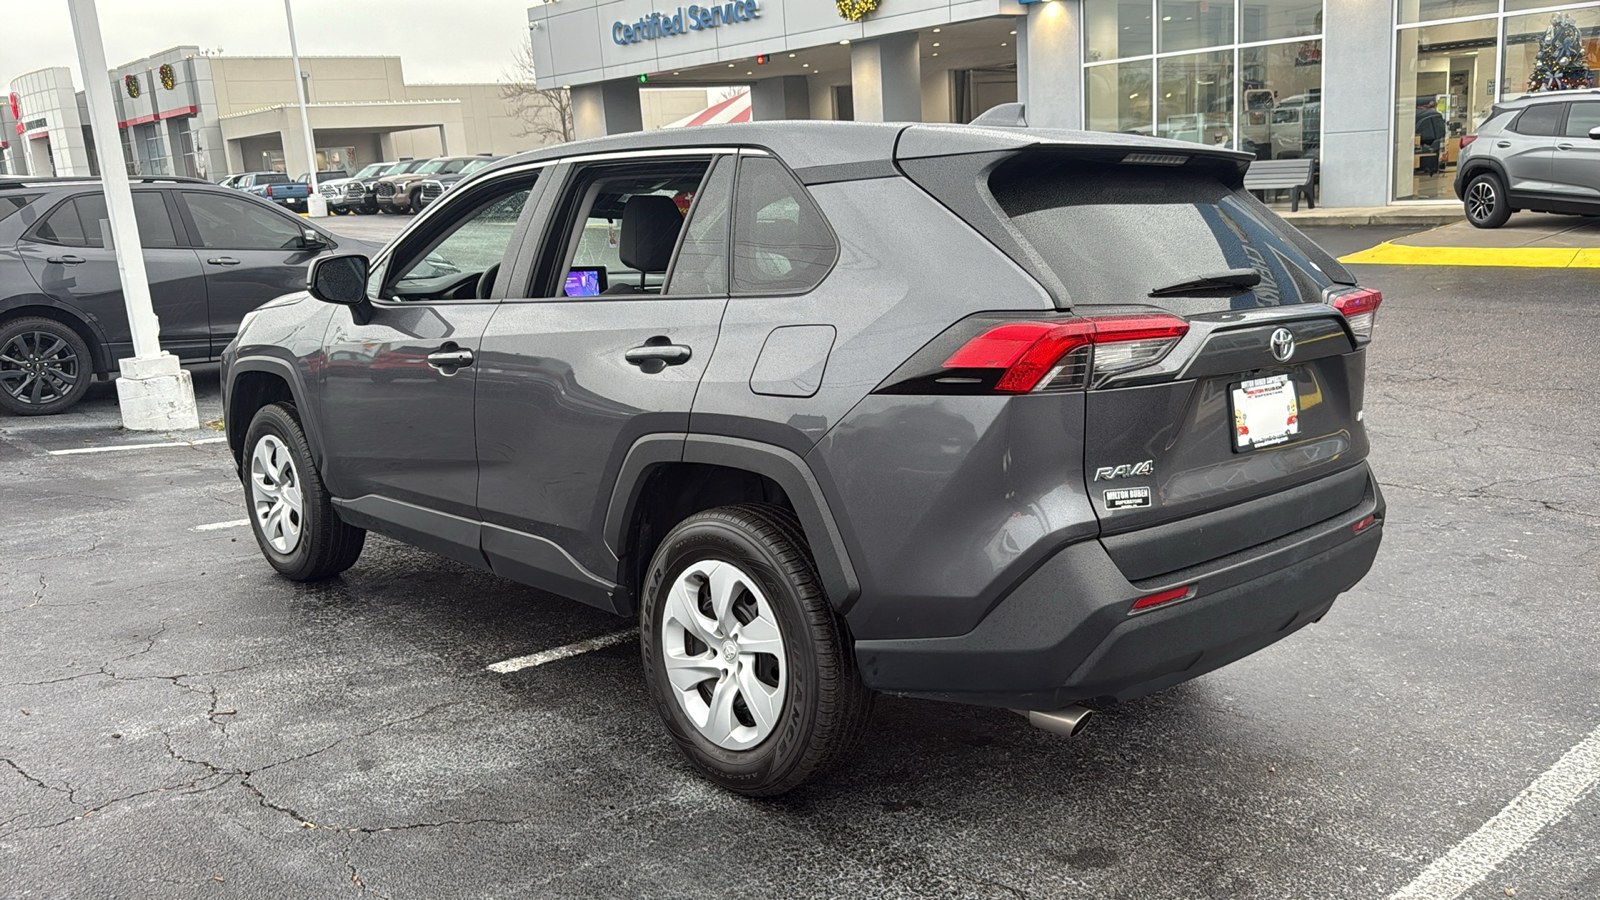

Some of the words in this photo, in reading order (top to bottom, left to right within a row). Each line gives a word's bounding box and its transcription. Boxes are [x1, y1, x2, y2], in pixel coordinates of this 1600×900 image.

[612, 7, 685, 46] Certified
[688, 0, 758, 31] Service
[1094, 459, 1154, 482] RAV4
[1106, 491, 1129, 500] MILTON
